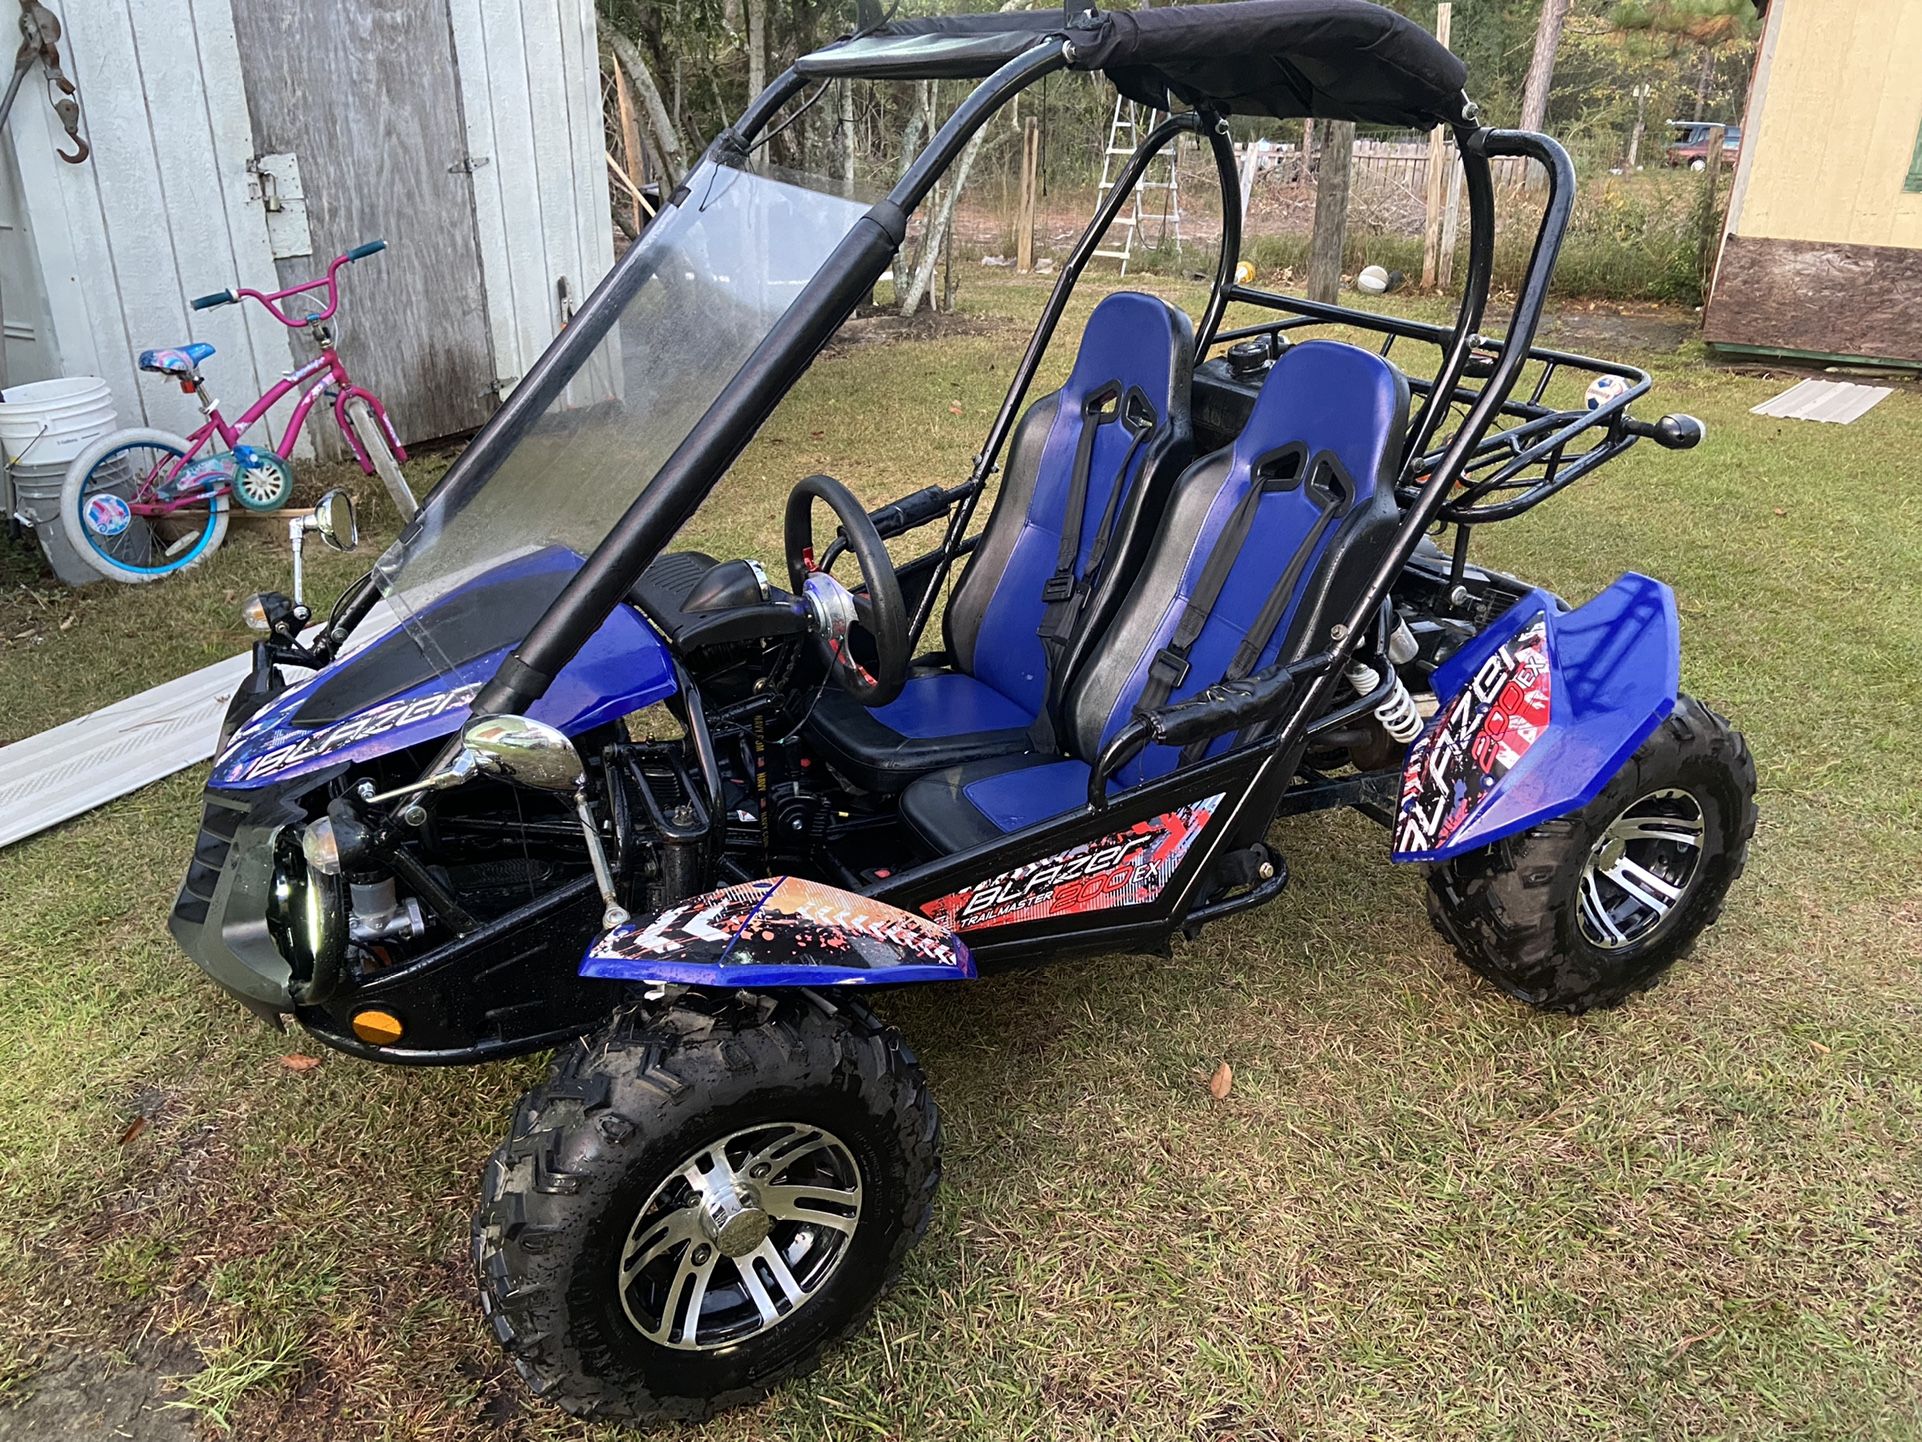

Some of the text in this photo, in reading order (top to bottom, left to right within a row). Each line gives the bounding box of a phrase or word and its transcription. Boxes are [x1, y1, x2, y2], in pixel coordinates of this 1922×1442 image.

[246, 682, 482, 780] BLAZER
[756, 771, 768, 792] NAVY
[961, 834, 1151, 916] BLAZER
[960, 890, 1054, 928] TRAILMASTER
